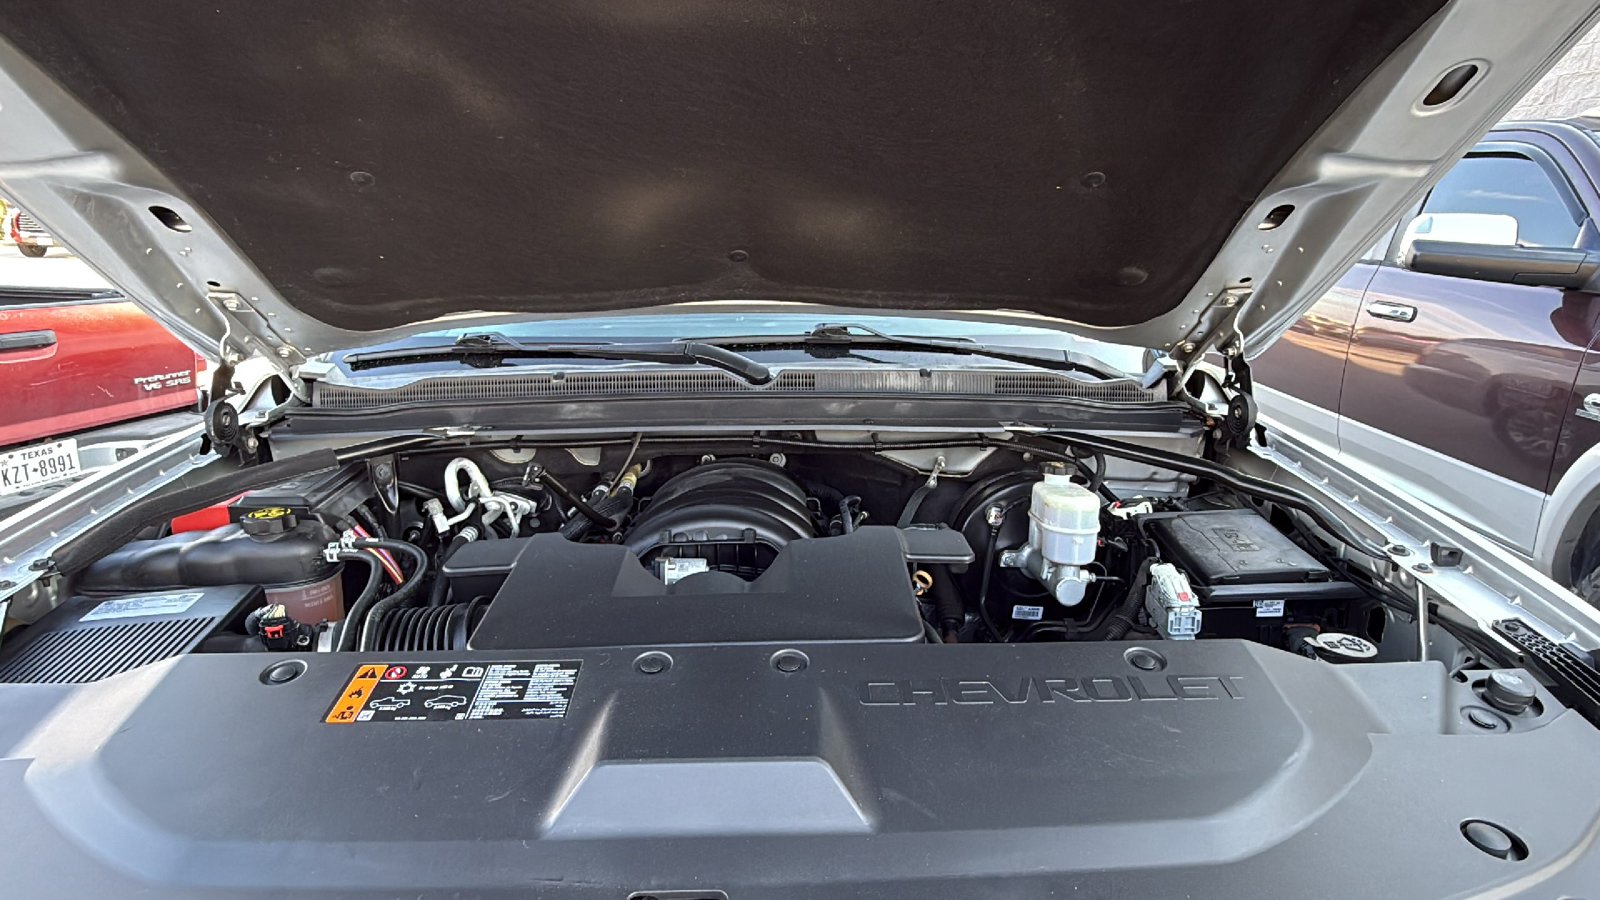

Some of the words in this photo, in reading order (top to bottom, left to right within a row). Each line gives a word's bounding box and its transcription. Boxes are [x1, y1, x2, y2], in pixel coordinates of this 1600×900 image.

[143, 382, 162, 391] V6
[21, 447, 53, 460] TEXAS
[859, 676, 1246, 705] CHEVROLET
